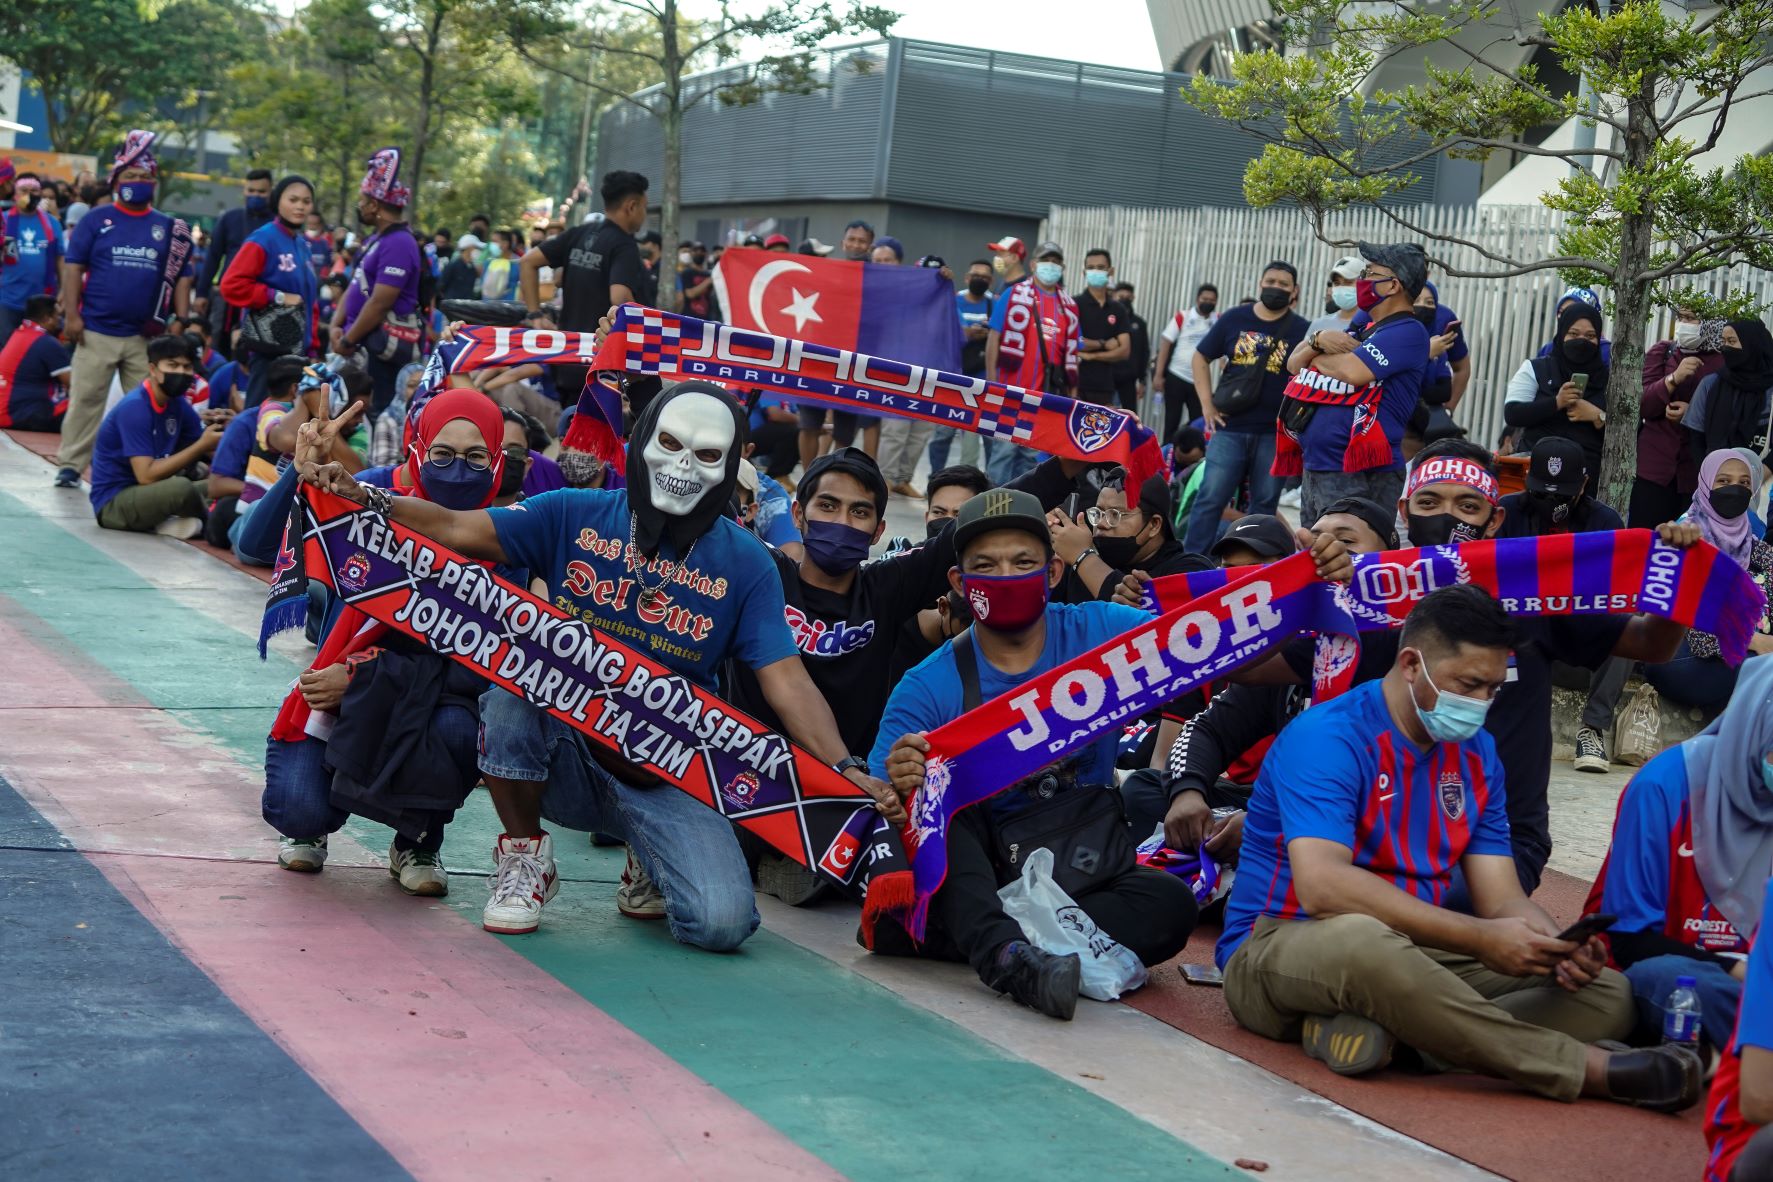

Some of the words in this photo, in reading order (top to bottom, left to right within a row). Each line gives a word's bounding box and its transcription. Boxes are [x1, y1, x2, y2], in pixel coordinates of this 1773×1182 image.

[112, 245, 146, 256] unicef
[681, 322, 986, 408] JOHOR
[1363, 342, 1389, 366] JCORP
[692, 362, 808, 389] DARUL
[831, 384, 966, 421] TAKZIM
[1419, 459, 1492, 490] JOHOR
[1422, 473, 1457, 483] DARUL
[575, 527, 623, 560] Los
[555, 595, 579, 617] The
[582, 609, 647, 642] Southern
[650, 633, 703, 662] Pirates
[562, 560, 635, 612] Del
[637, 588, 714, 642] Sur
[347, 512, 436, 579] KELAB
[438, 560, 625, 684] PENYOKONG
[623, 665, 794, 780] BOLASEPAK
[1007, 580, 1283, 752] JOHOR
[394, 591, 500, 668] JOHOR
[498, 645, 594, 722] DARUL
[594, 700, 696, 779] TA'ZIM
[1048, 700, 1147, 754] DARUL
[1151, 636, 1269, 698] TAKZIM
[1683, 918, 1729, 933] FOREST
